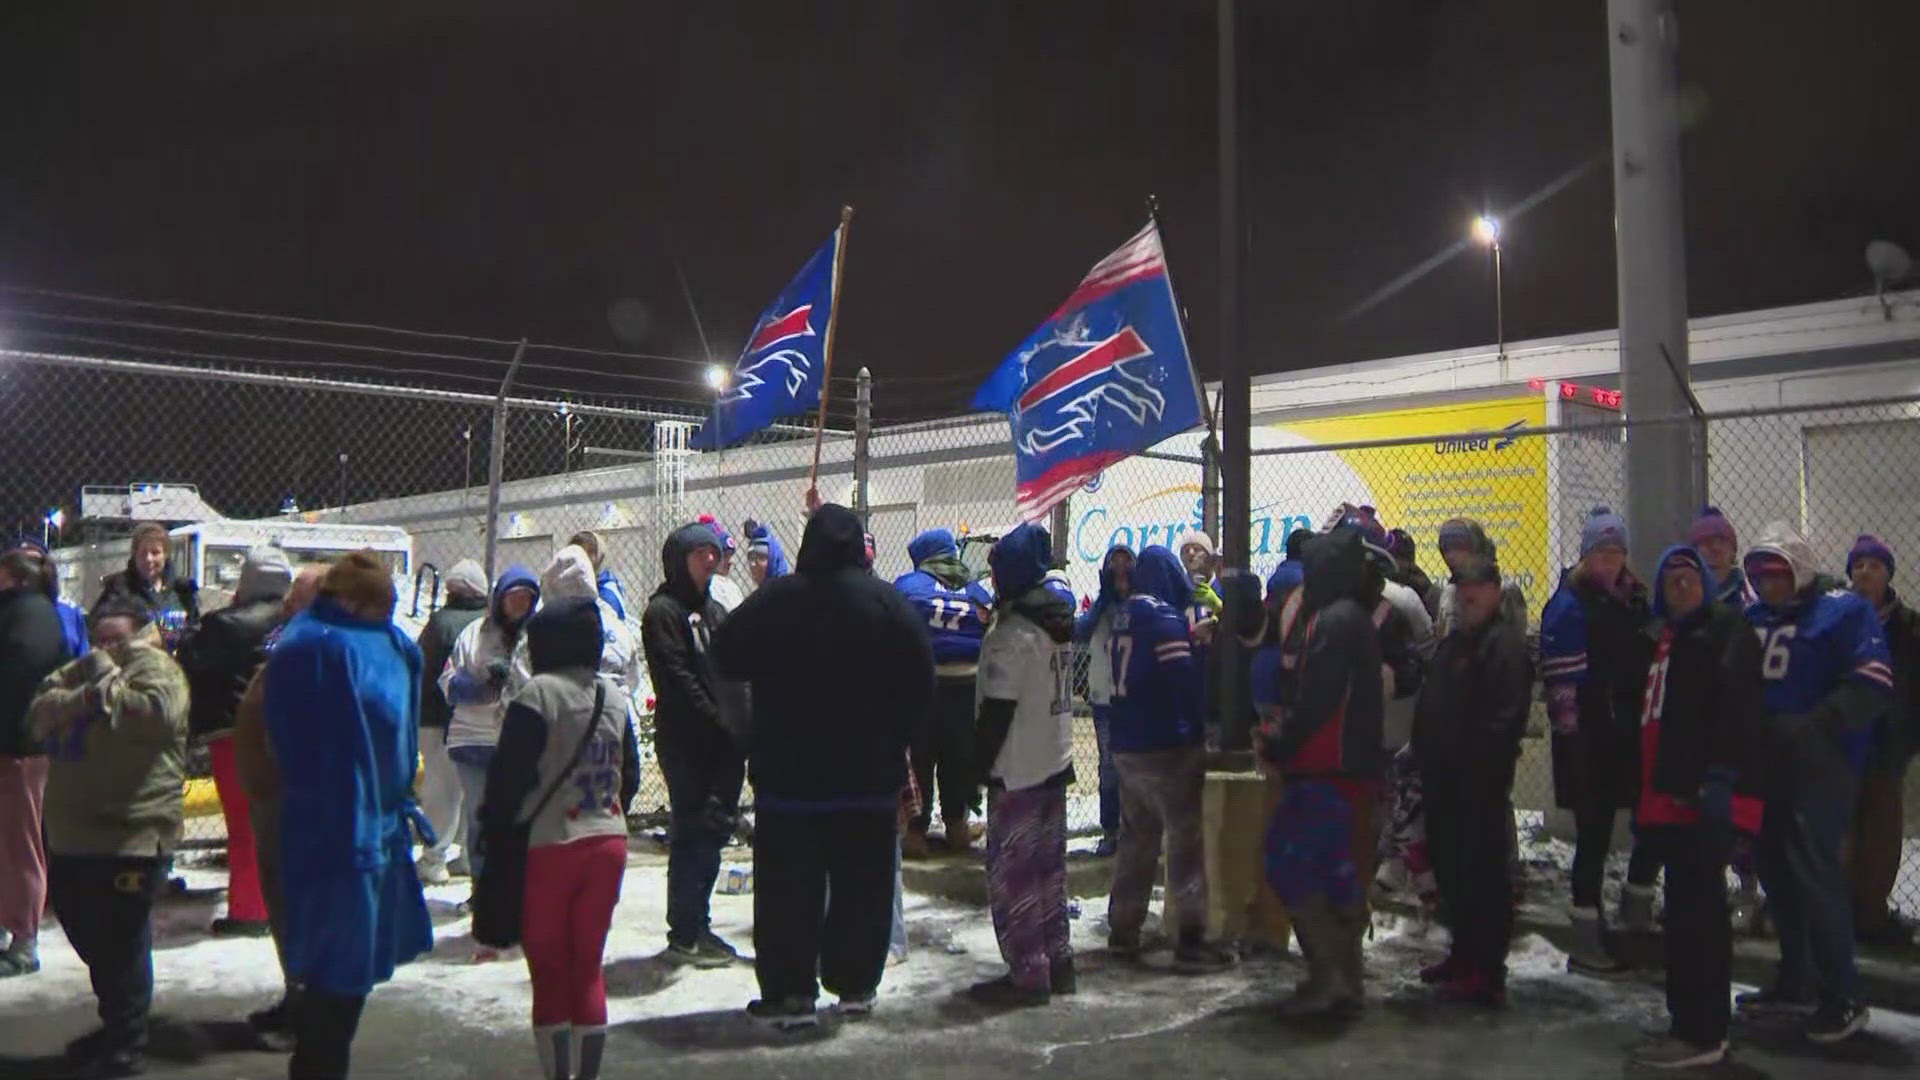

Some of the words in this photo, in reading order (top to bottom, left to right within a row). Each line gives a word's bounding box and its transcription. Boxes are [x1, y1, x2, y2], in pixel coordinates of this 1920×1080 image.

[1434, 434, 1489, 455] United
[1076, 498, 1312, 562] Corrian
[928, 598, 971, 631] 17
